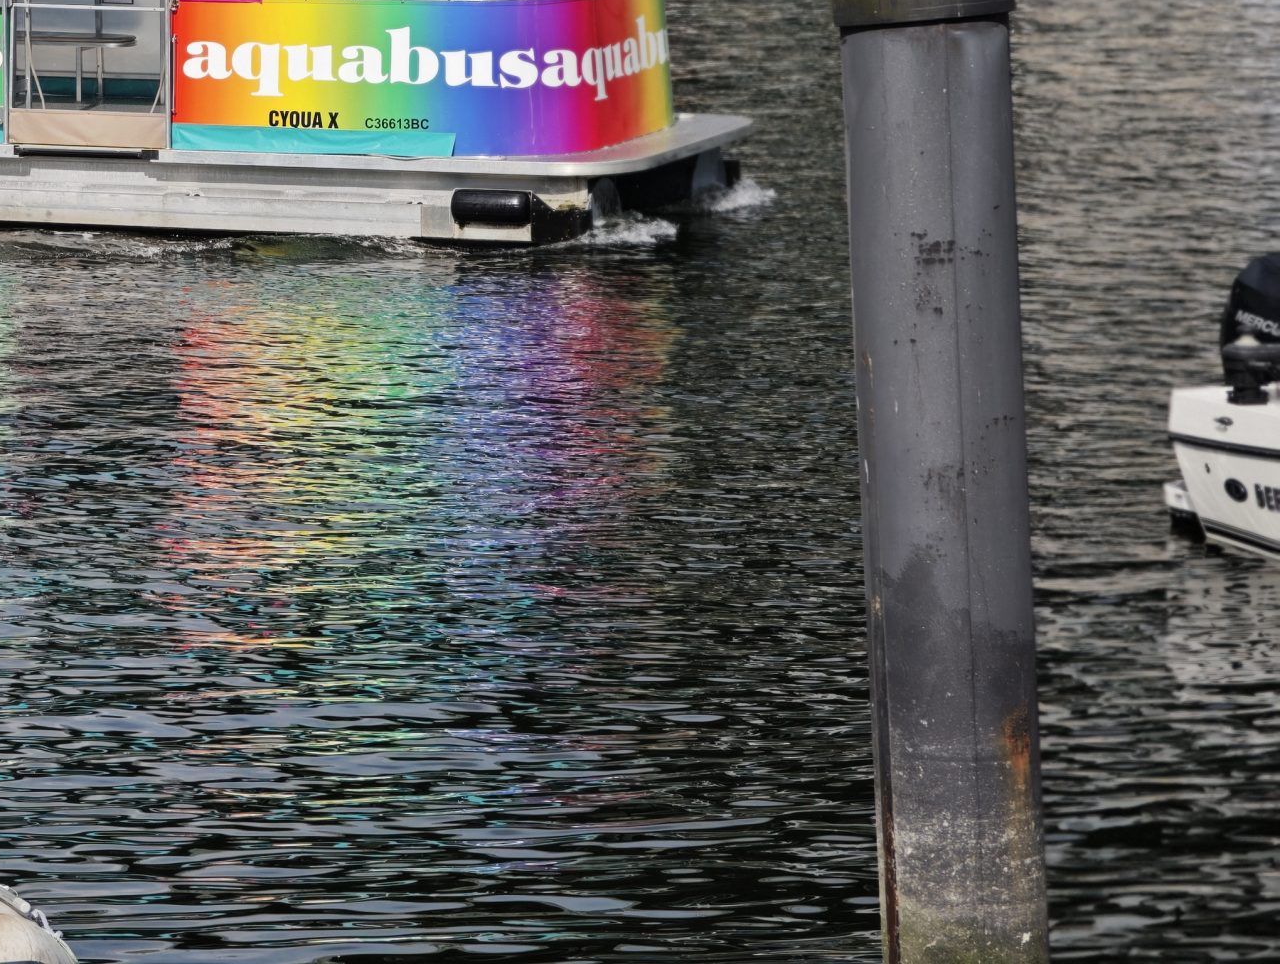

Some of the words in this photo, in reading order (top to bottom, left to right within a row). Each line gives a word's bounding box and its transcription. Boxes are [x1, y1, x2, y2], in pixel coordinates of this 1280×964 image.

[268, 109, 323, 129] CYQUA
[327, 112, 339, 129] X
[364, 117, 430, 130] C36613BC
